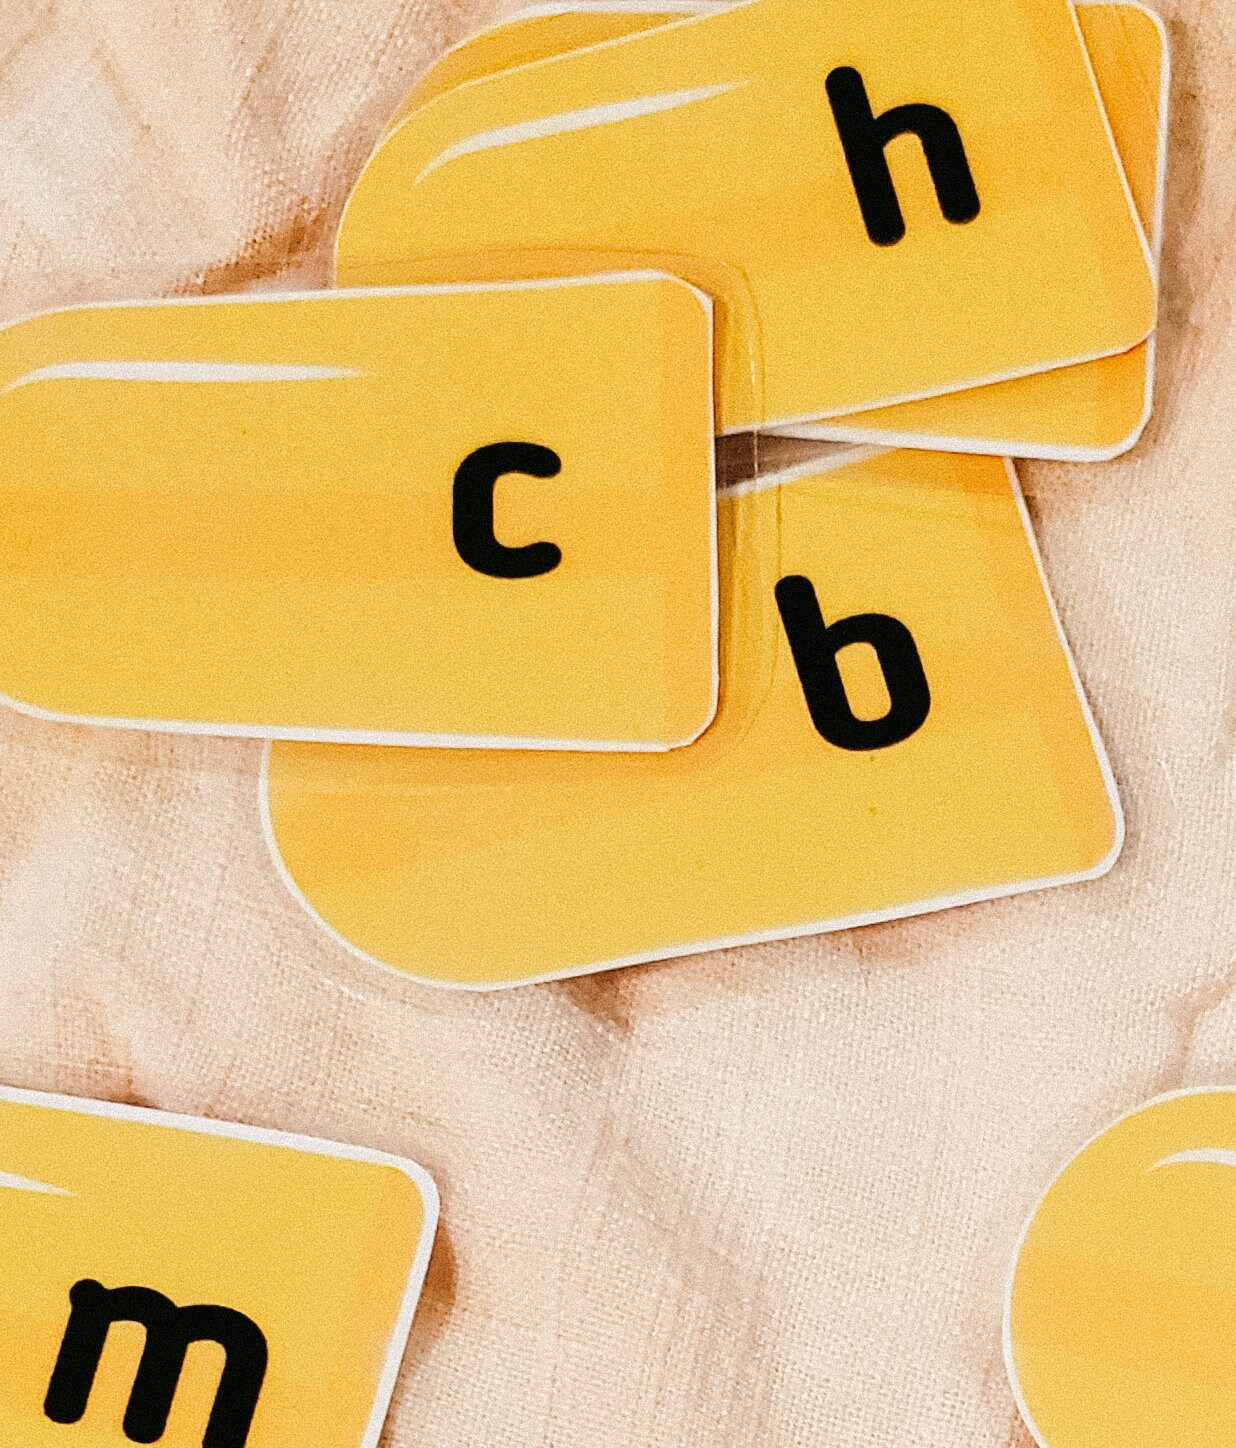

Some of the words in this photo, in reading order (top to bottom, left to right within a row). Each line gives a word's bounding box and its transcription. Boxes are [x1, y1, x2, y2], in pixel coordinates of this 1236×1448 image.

[824, 66, 981, 246] h
[452, 441, 562, 579] c
[774, 574, 931, 751] b
